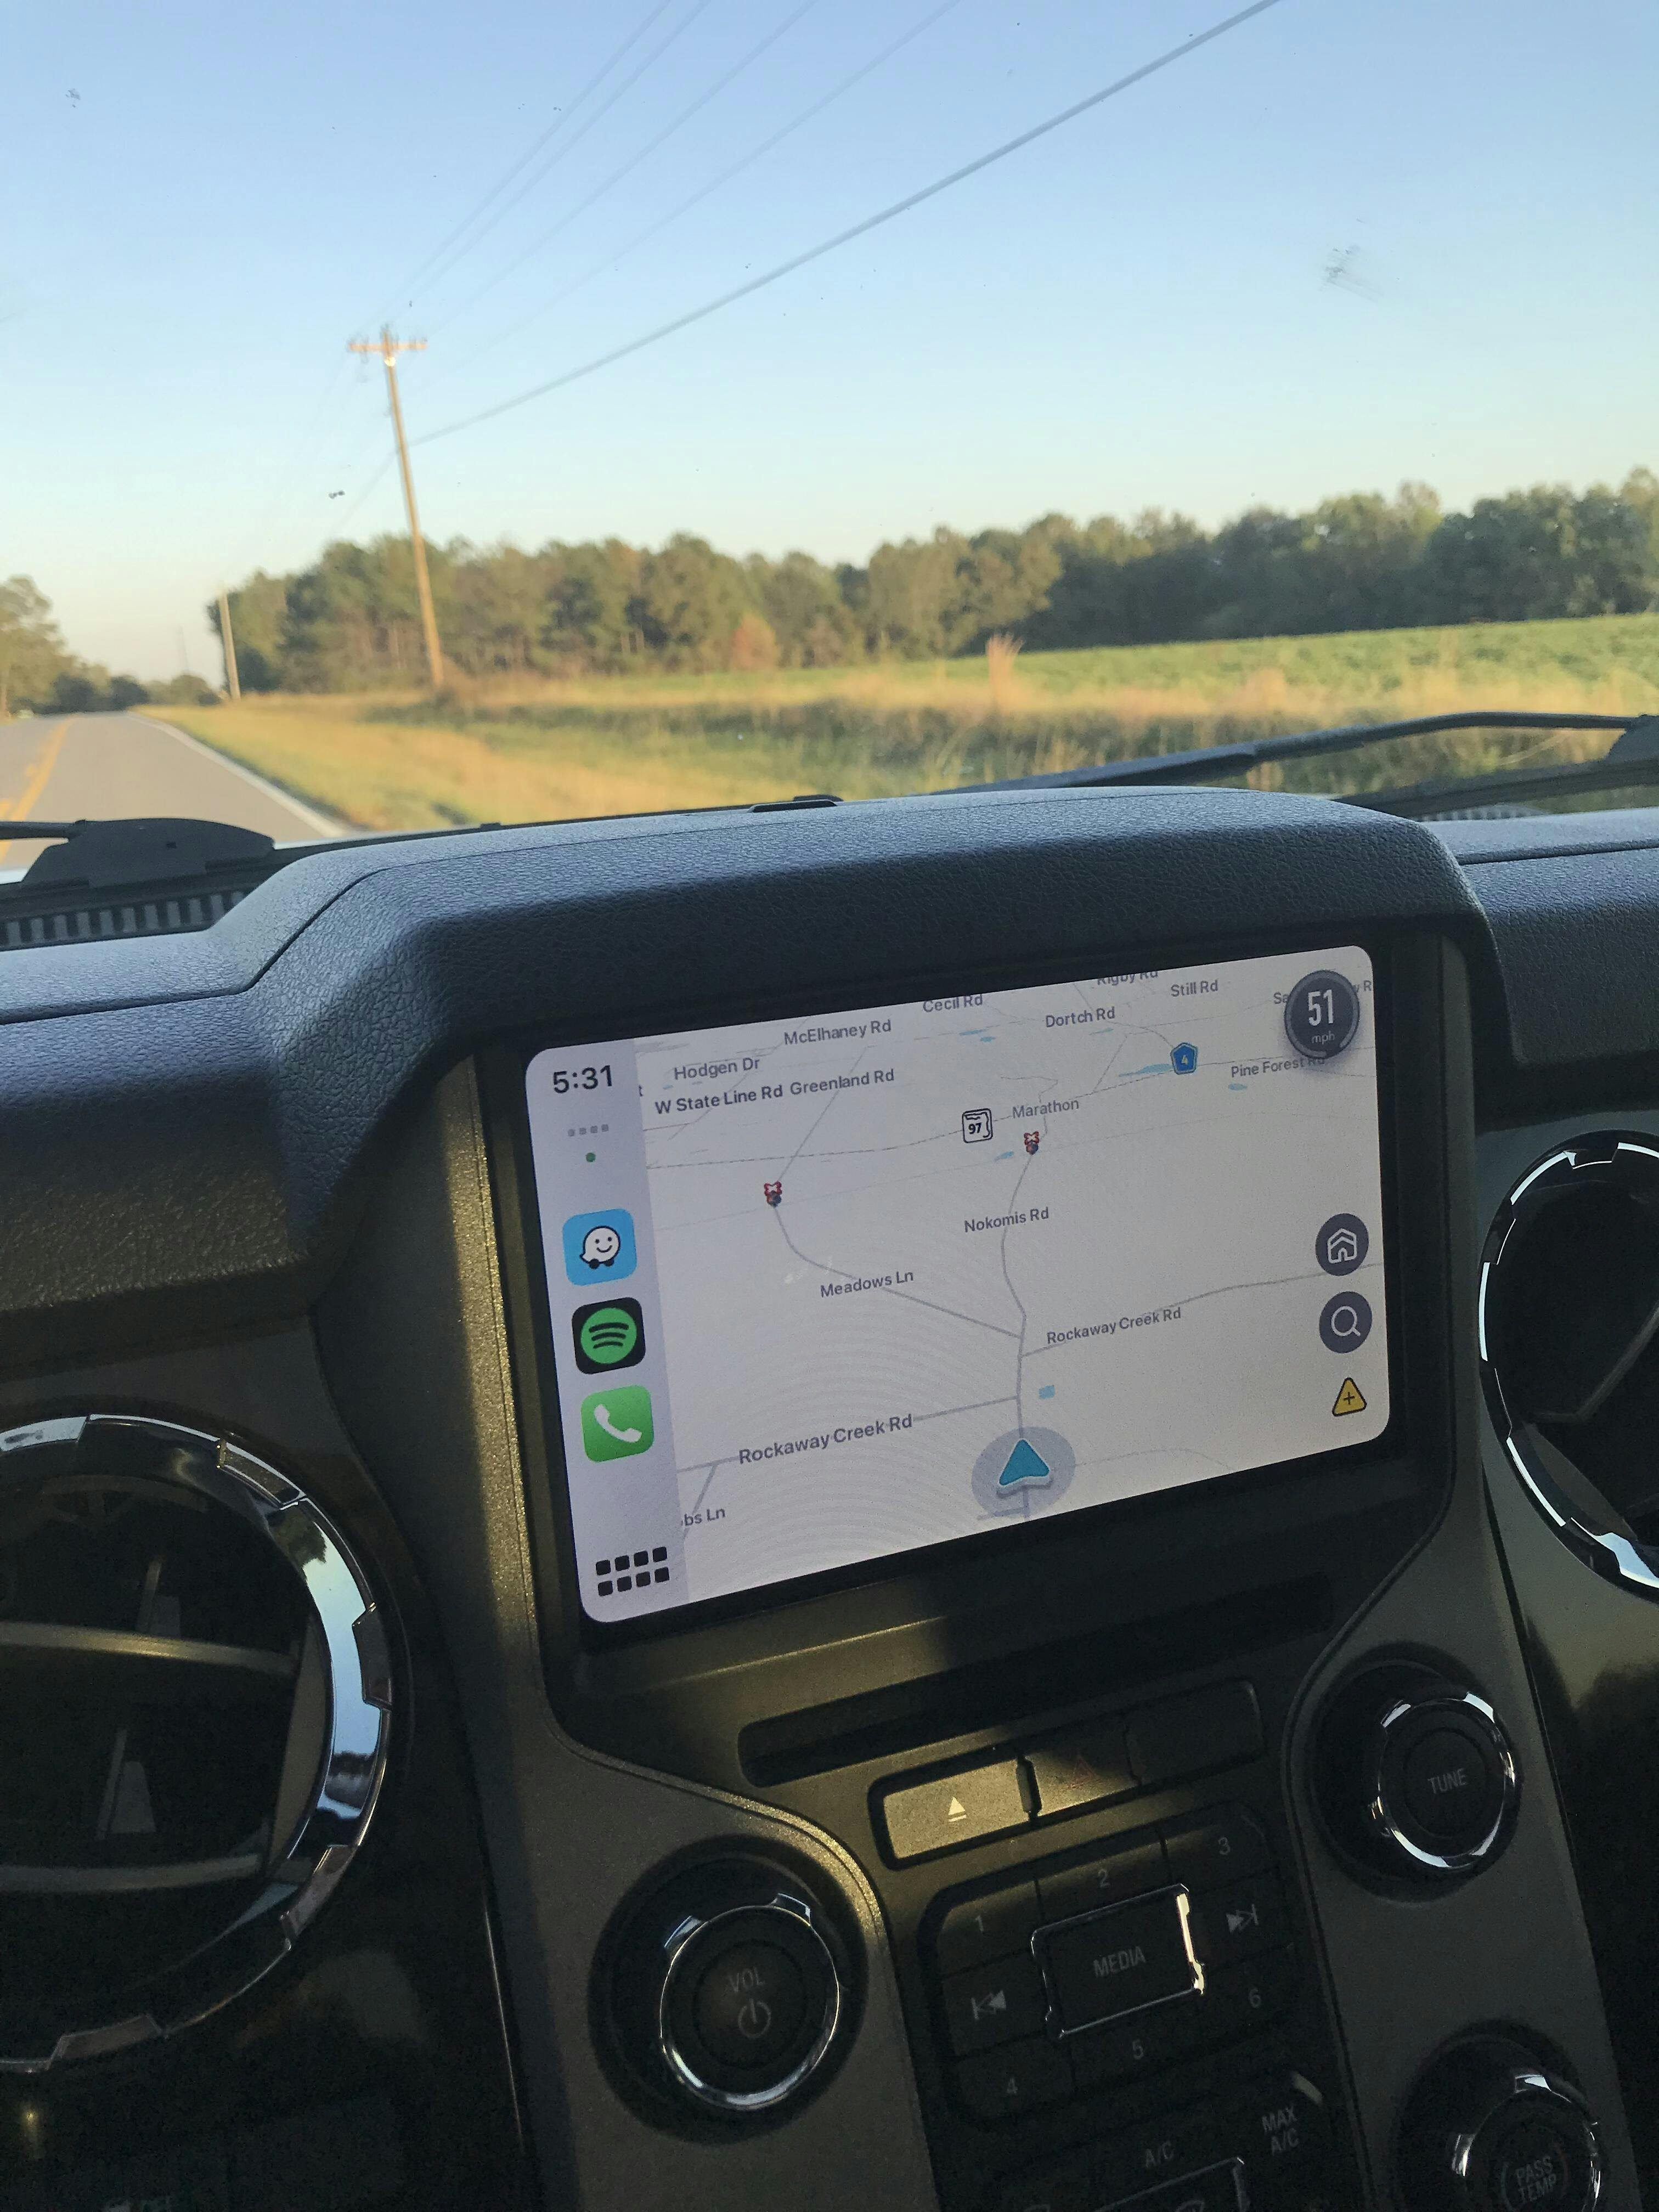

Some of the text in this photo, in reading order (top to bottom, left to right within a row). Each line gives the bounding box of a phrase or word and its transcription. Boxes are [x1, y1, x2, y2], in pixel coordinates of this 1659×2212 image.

[1170, 978, 1218, 997] Still Rd
[923, 994, 983, 1013] Cecil Rd
[1308, 989, 1334, 1026] 51
[1045, 1006, 1116, 1028] Dortch Rd
[784, 1019, 891, 1045] McElhaney Rd
[1311, 1031, 1335, 1045] mph
[552, 1064, 613, 1094] 5:31
[674, 1057, 760, 1080] Hodgen Dr
[1231, 1064, 1259, 1078] Pine
[1262, 1057, 1304, 1073] Forest
[790, 1068, 895, 1096] Greenland Rd
[655, 1084, 783, 1115] W State Line Rd
[1012, 1099, 1079, 1119] Marathon
[968, 1122, 982, 1135] 97
[964, 1206, 1049, 1233] Nokomis Rd
[820, 1271, 914, 1298] Meadows Ln
[1047, 1307, 1181, 1344] Rockaway Creek Rd
[739, 1413, 913, 1464] Rockaway Creek Rd
[681, 1508, 726, 1527] bs Ln
[1427, 1767, 1467, 1795] TUNE
[1218, 1837, 1232, 1856] 3
[1097, 1868, 1110, 1888] 2
[974, 1914, 985, 1933] 1
[1092, 1945, 1147, 1977] MEDIA
[727, 1967, 765, 1993] VOL
[1249, 1988, 1262, 2008] 6
[1132, 2040, 1144, 2059] 5
[1006, 2076, 1018, 2095] 4
[1262, 2102, 1297, 2133] MAX
[1271, 2128, 1299, 2155] A/C
[1145, 2141, 1175, 2169] A/C
[1515, 2155, 1553, 2187] PASS
[1518, 2172, 1557, 2204] TEMP
